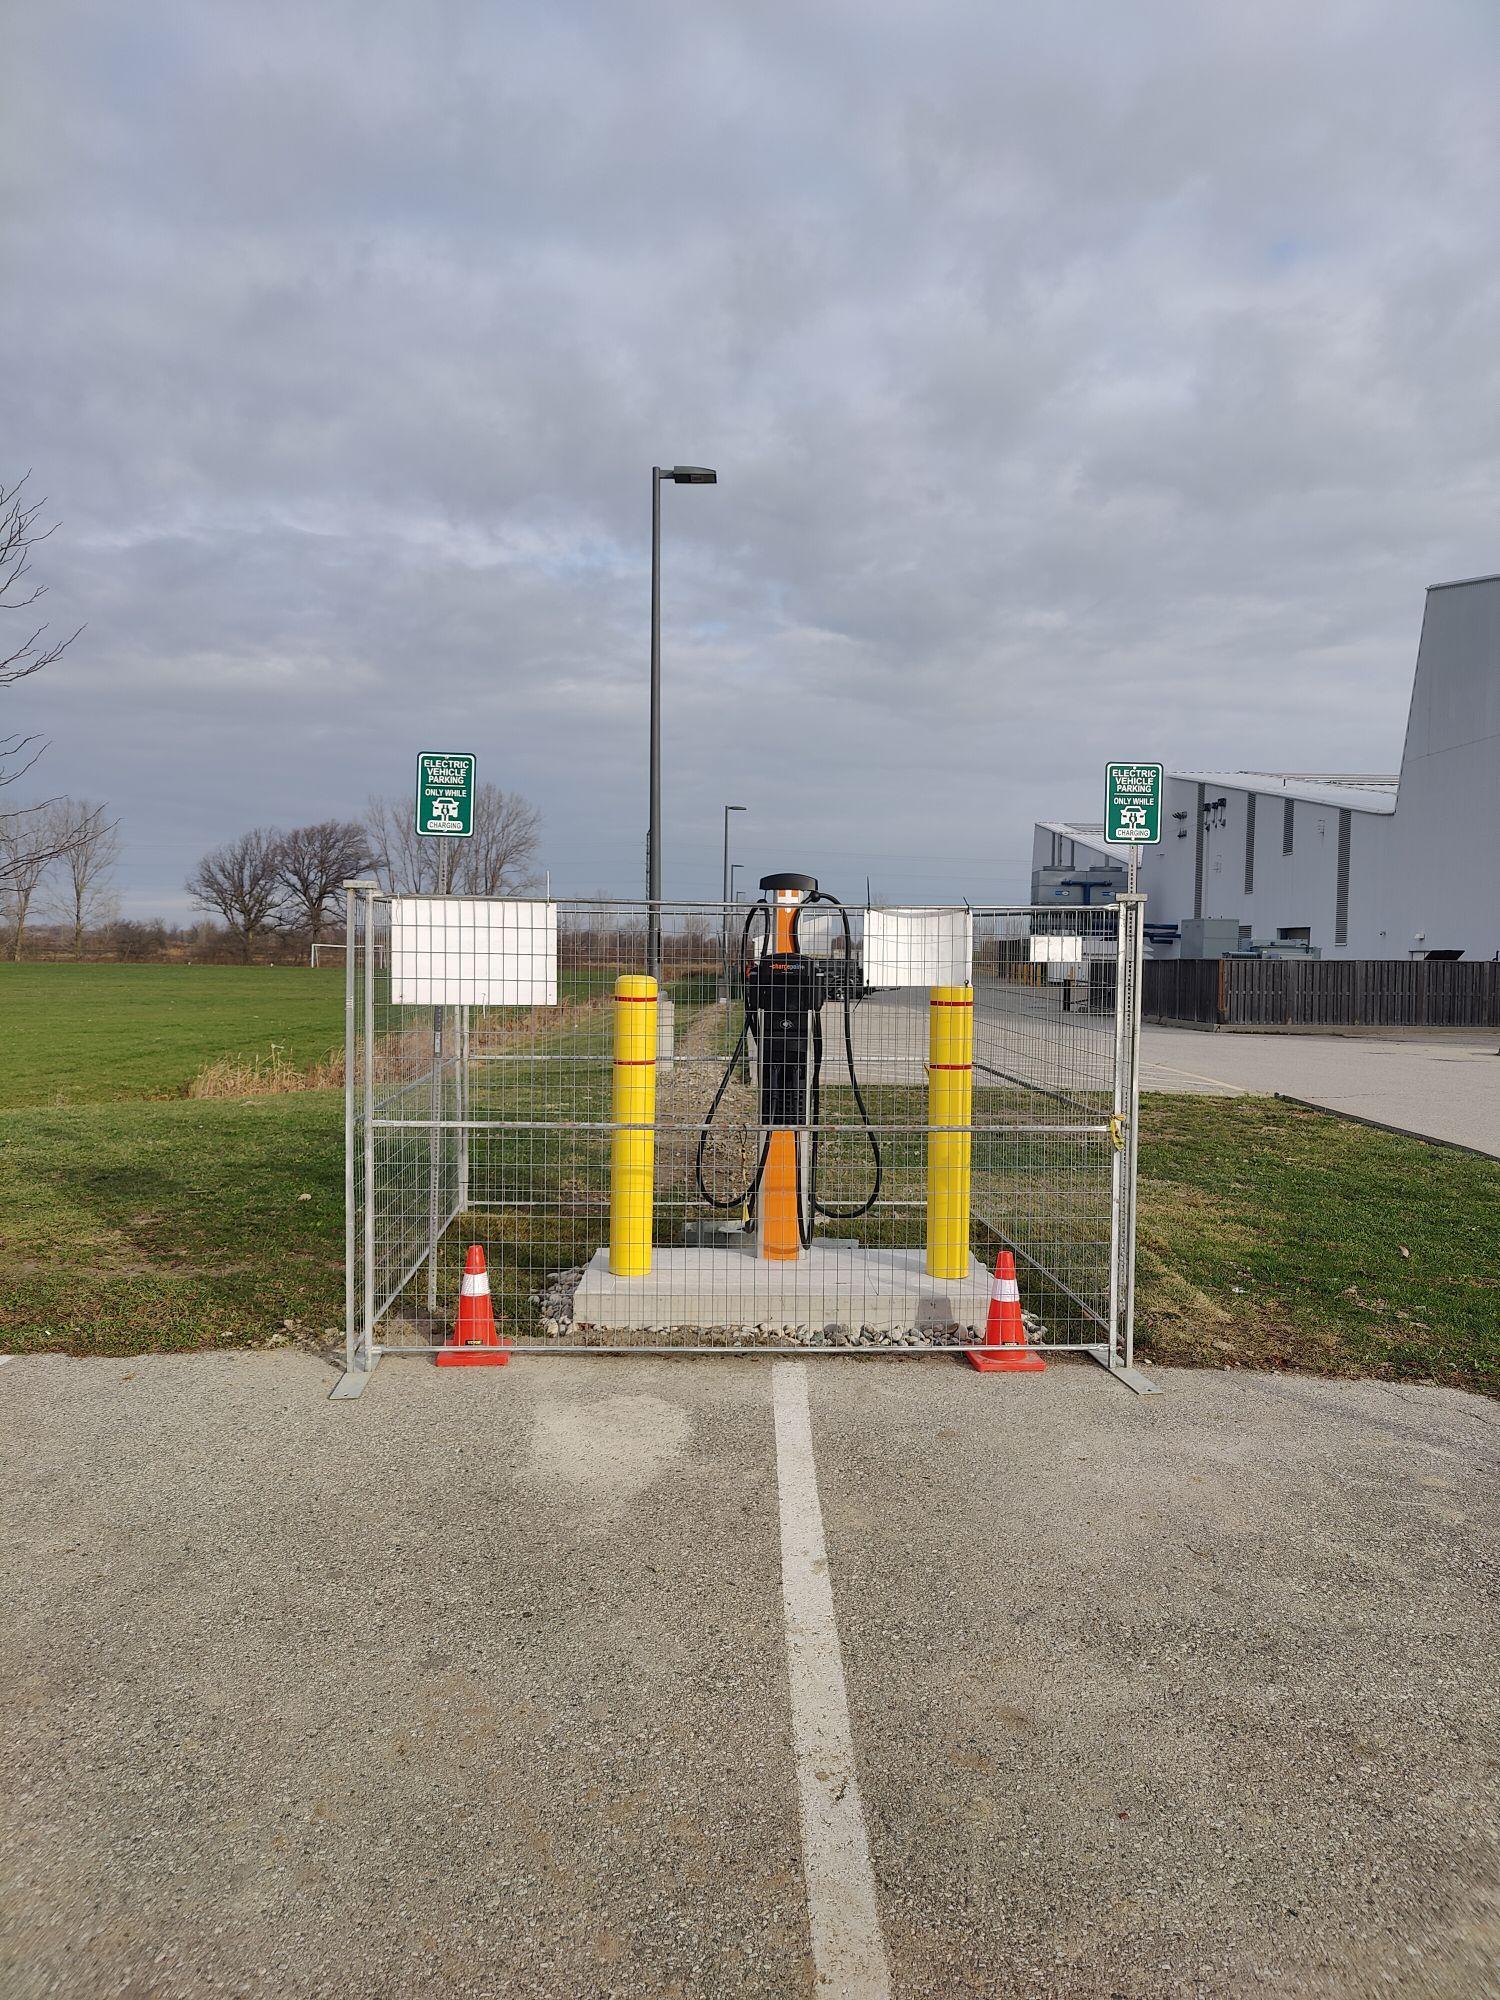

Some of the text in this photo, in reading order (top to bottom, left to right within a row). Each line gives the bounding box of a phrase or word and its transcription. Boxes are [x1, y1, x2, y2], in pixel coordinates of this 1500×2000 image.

[424, 759, 469, 769] ELECTRIC
[426, 768, 466, 777] VEHICLE
[1112, 769, 1156, 777] ELECTRIC
[428, 776, 464, 784] PARKING
[1115, 777, 1154, 785] VEHICLE
[425, 788, 467, 797] ONLY WHILE
[1116, 784, 1152, 793] PARKING
[1113, 797, 1154, 806] ONLY WHILE
[429, 821, 461, 829] CHARGING
[1117, 829, 1149, 837] CHARGING
